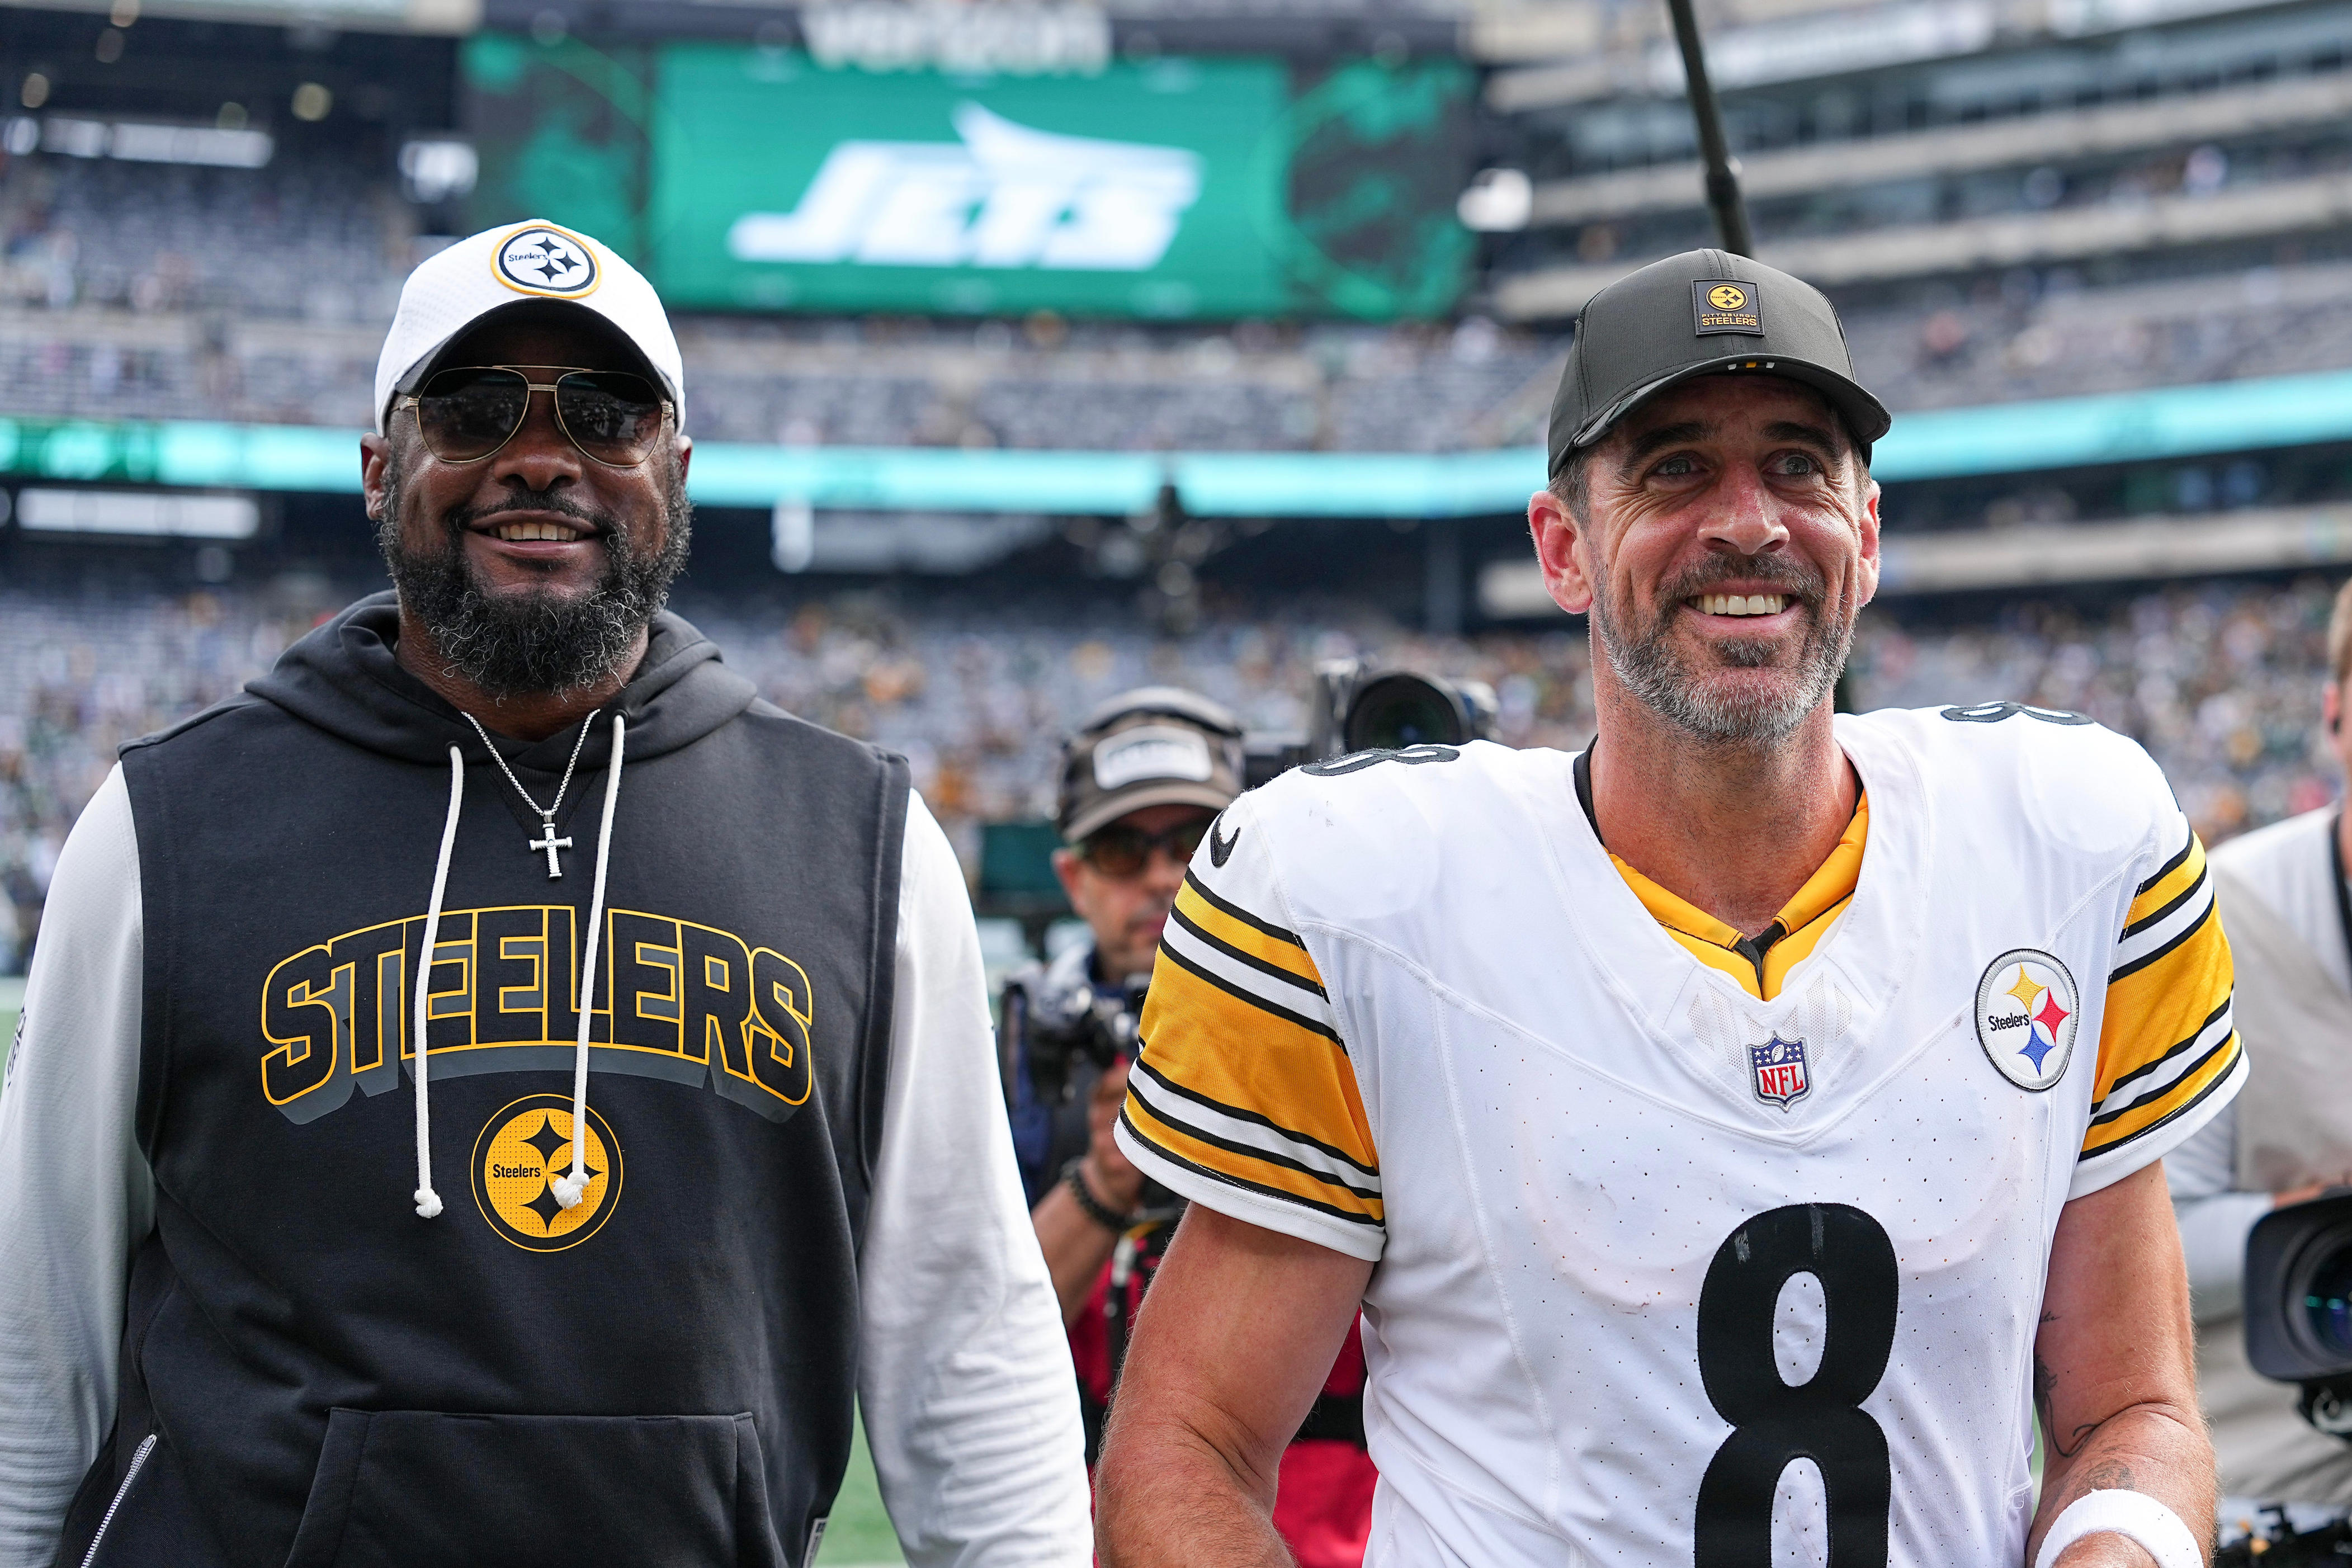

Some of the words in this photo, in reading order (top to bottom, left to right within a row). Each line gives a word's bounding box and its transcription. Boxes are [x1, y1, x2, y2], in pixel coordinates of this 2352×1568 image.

[729, 102, 1204, 271] JETS
[509, 252, 547, 262] Steelers
[1702, 317, 1757, 326] STEELERS
[261, 905, 813, 1106] STEELERS
[1989, 1012, 2030, 1032] Steelers
[1760, 1065, 1804, 1096] NFL
[493, 1164, 541, 1178] Steelers
[1694, 1203, 1898, 1567] 8
